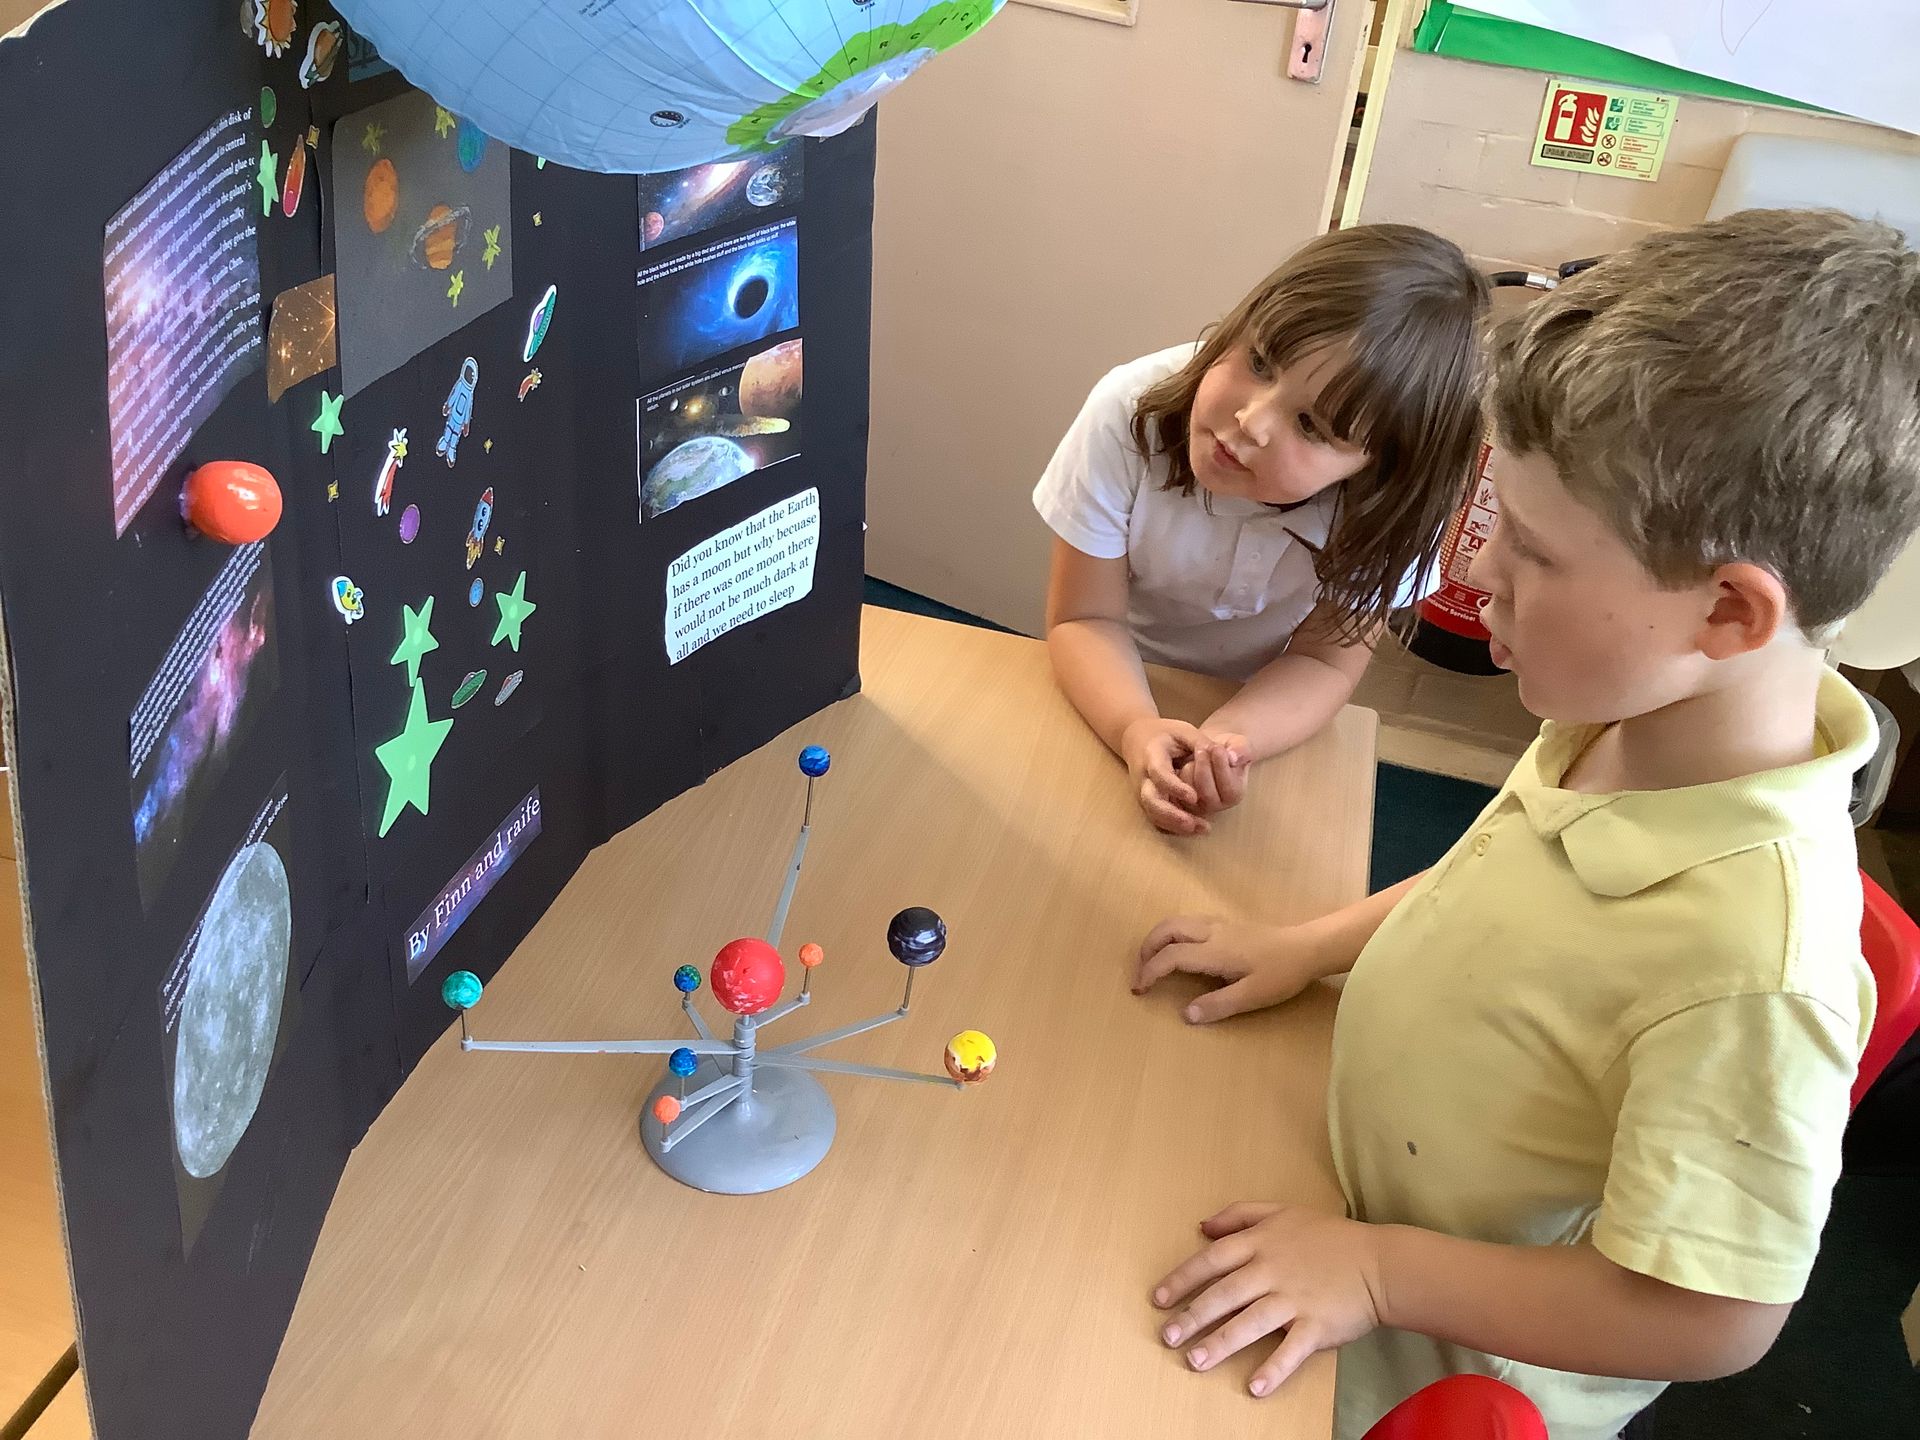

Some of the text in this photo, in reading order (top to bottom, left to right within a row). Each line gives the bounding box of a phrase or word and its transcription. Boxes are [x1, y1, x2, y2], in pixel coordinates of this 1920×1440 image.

[228, 111, 242, 125] disk
[243, 107, 252, 120] of
[226, 133, 245, 151] central
[234, 159, 247, 174] glue
[230, 181, 251, 201] galaxy's
[233, 231, 244, 247] give
[245, 226, 256, 239] the
[246, 291, 260, 306] map
[251, 335, 261, 346] the
[671, 492, 816, 577] Did you know that the Earth
[673, 514, 816, 598] has a moon but why becuase
[674, 536, 814, 619] if there was one moon there
[674, 557, 809, 639] would not be much dark at
[676, 585, 795, 660] all and we need to sleep
[408, 796, 540, 960] By Finn and raife
